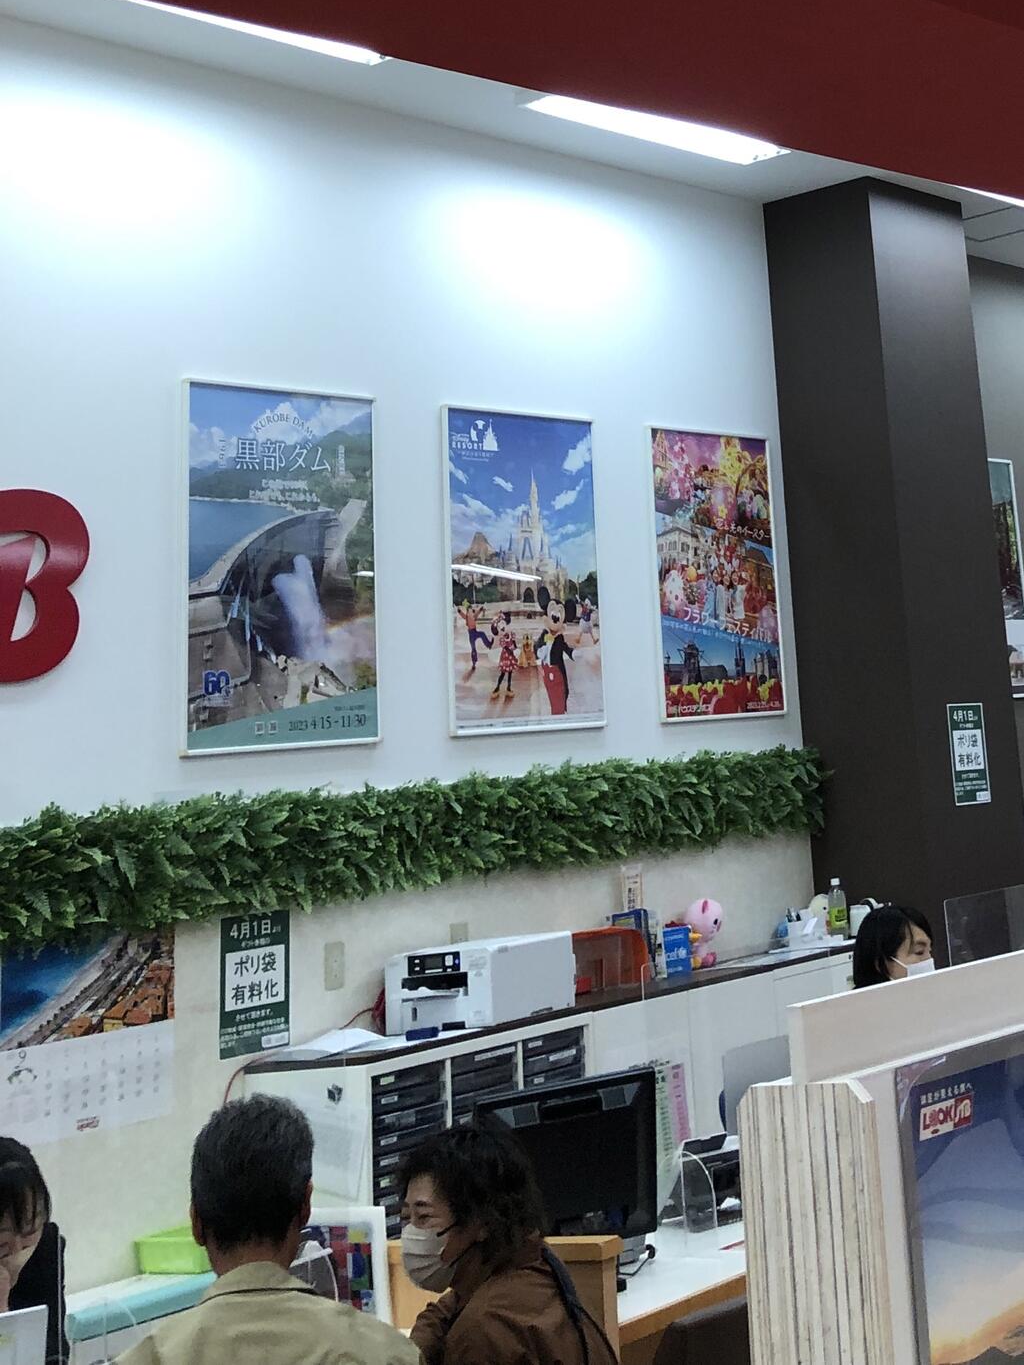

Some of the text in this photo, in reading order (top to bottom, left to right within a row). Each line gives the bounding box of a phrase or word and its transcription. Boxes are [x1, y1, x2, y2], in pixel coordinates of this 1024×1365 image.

[253, 412, 313, 440] KUROBE DAM
[235, 437, 332, 473] 黒部ダム
[234, 951, 277, 978] ポリ袋
[231, 978, 279, 1006] 有料化
